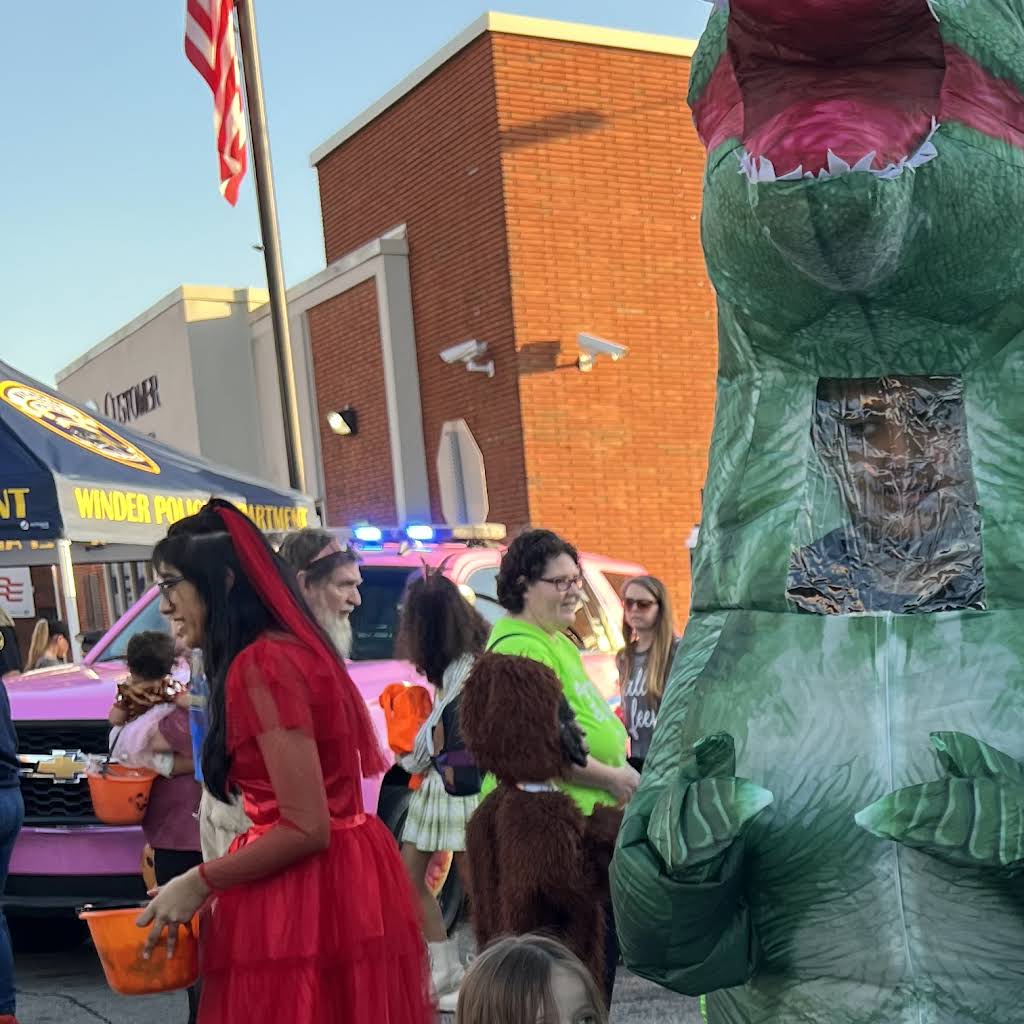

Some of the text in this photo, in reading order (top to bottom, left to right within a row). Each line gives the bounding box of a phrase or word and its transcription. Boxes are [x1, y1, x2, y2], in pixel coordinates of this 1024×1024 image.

[74, 487, 308, 531] WINDER POLIC PARTMENT
